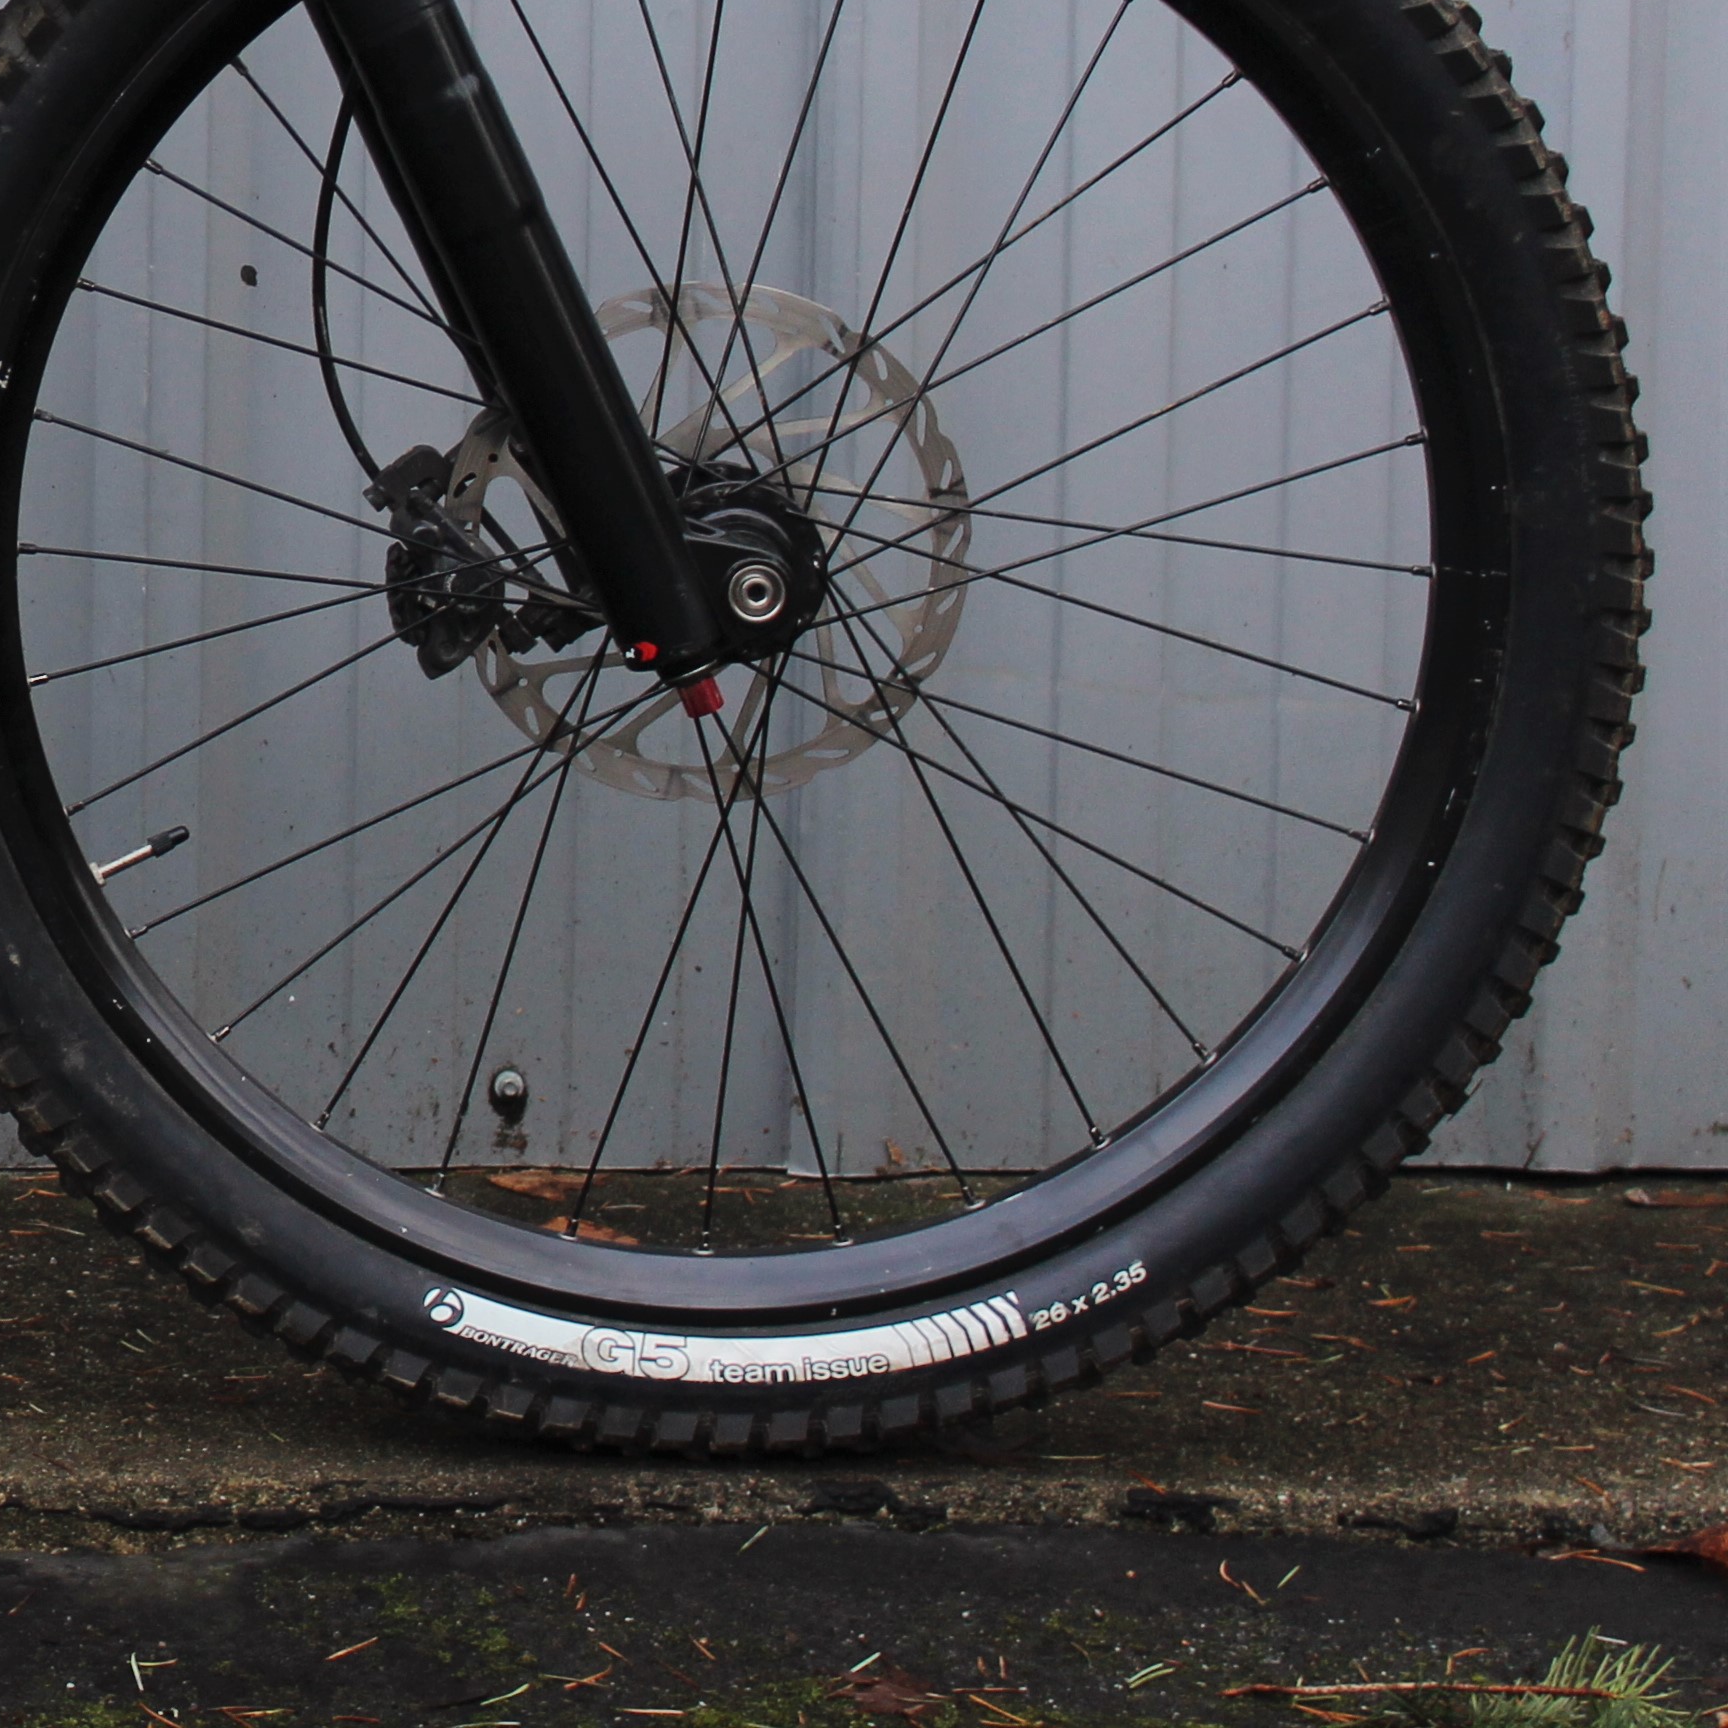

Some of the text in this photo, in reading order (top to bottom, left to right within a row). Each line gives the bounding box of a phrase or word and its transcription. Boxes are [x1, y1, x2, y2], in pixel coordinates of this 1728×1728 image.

[460, 1324, 581, 1368] BONTRAGER
[581, 1260, 1148, 1384] G5 team issue 26 x 2.35
